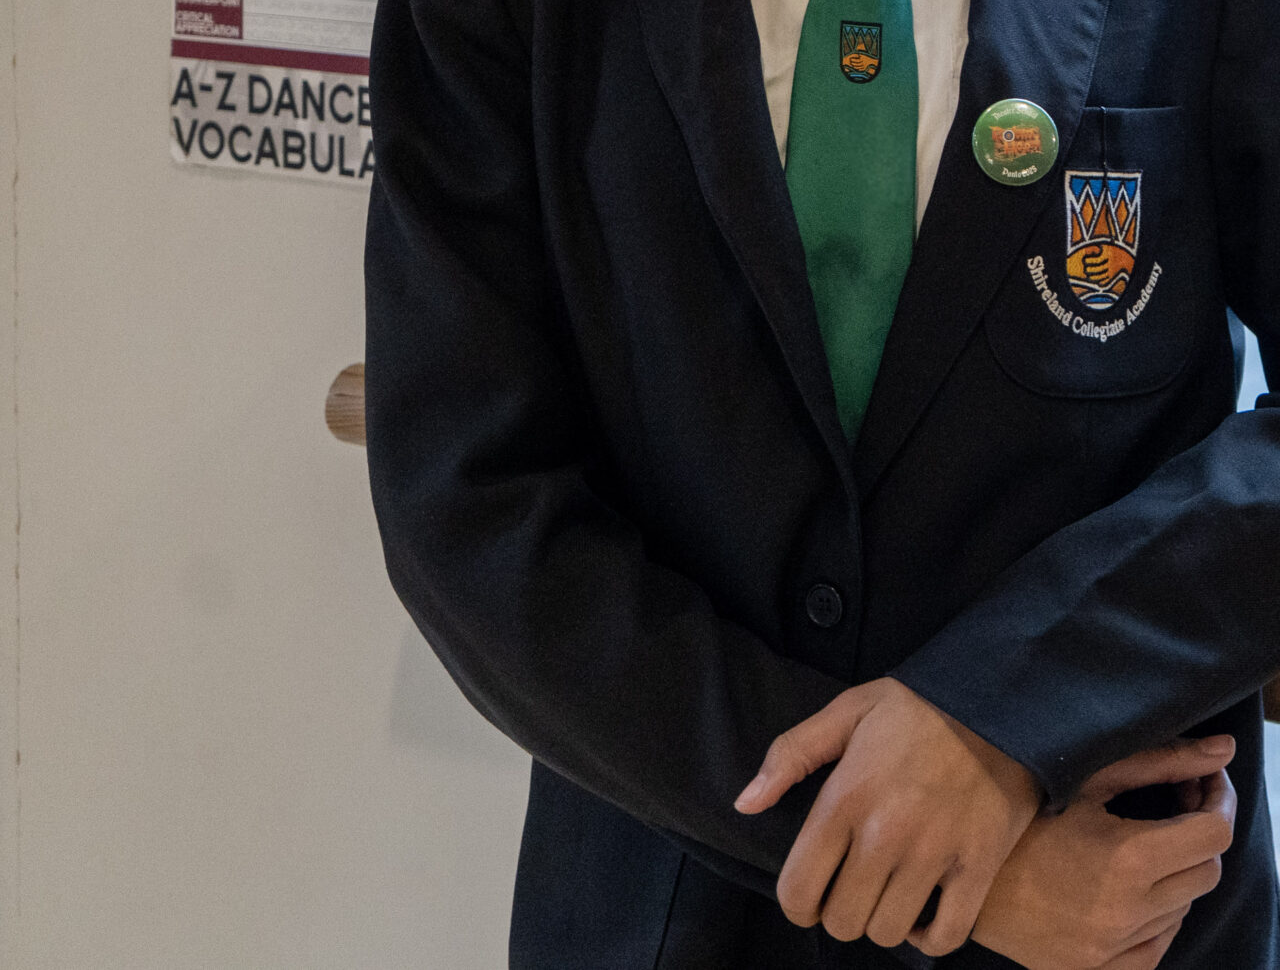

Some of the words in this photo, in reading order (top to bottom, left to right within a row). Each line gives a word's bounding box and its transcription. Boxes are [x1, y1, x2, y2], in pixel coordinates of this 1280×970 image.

[171, 67, 237, 112] A-Z
[248, 73, 373, 126] DANCE
[1027, 255, 1074, 327] Shireland
[1072, 315, 1125, 342] Collegiate
[1126, 261, 1163, 326] Academy
